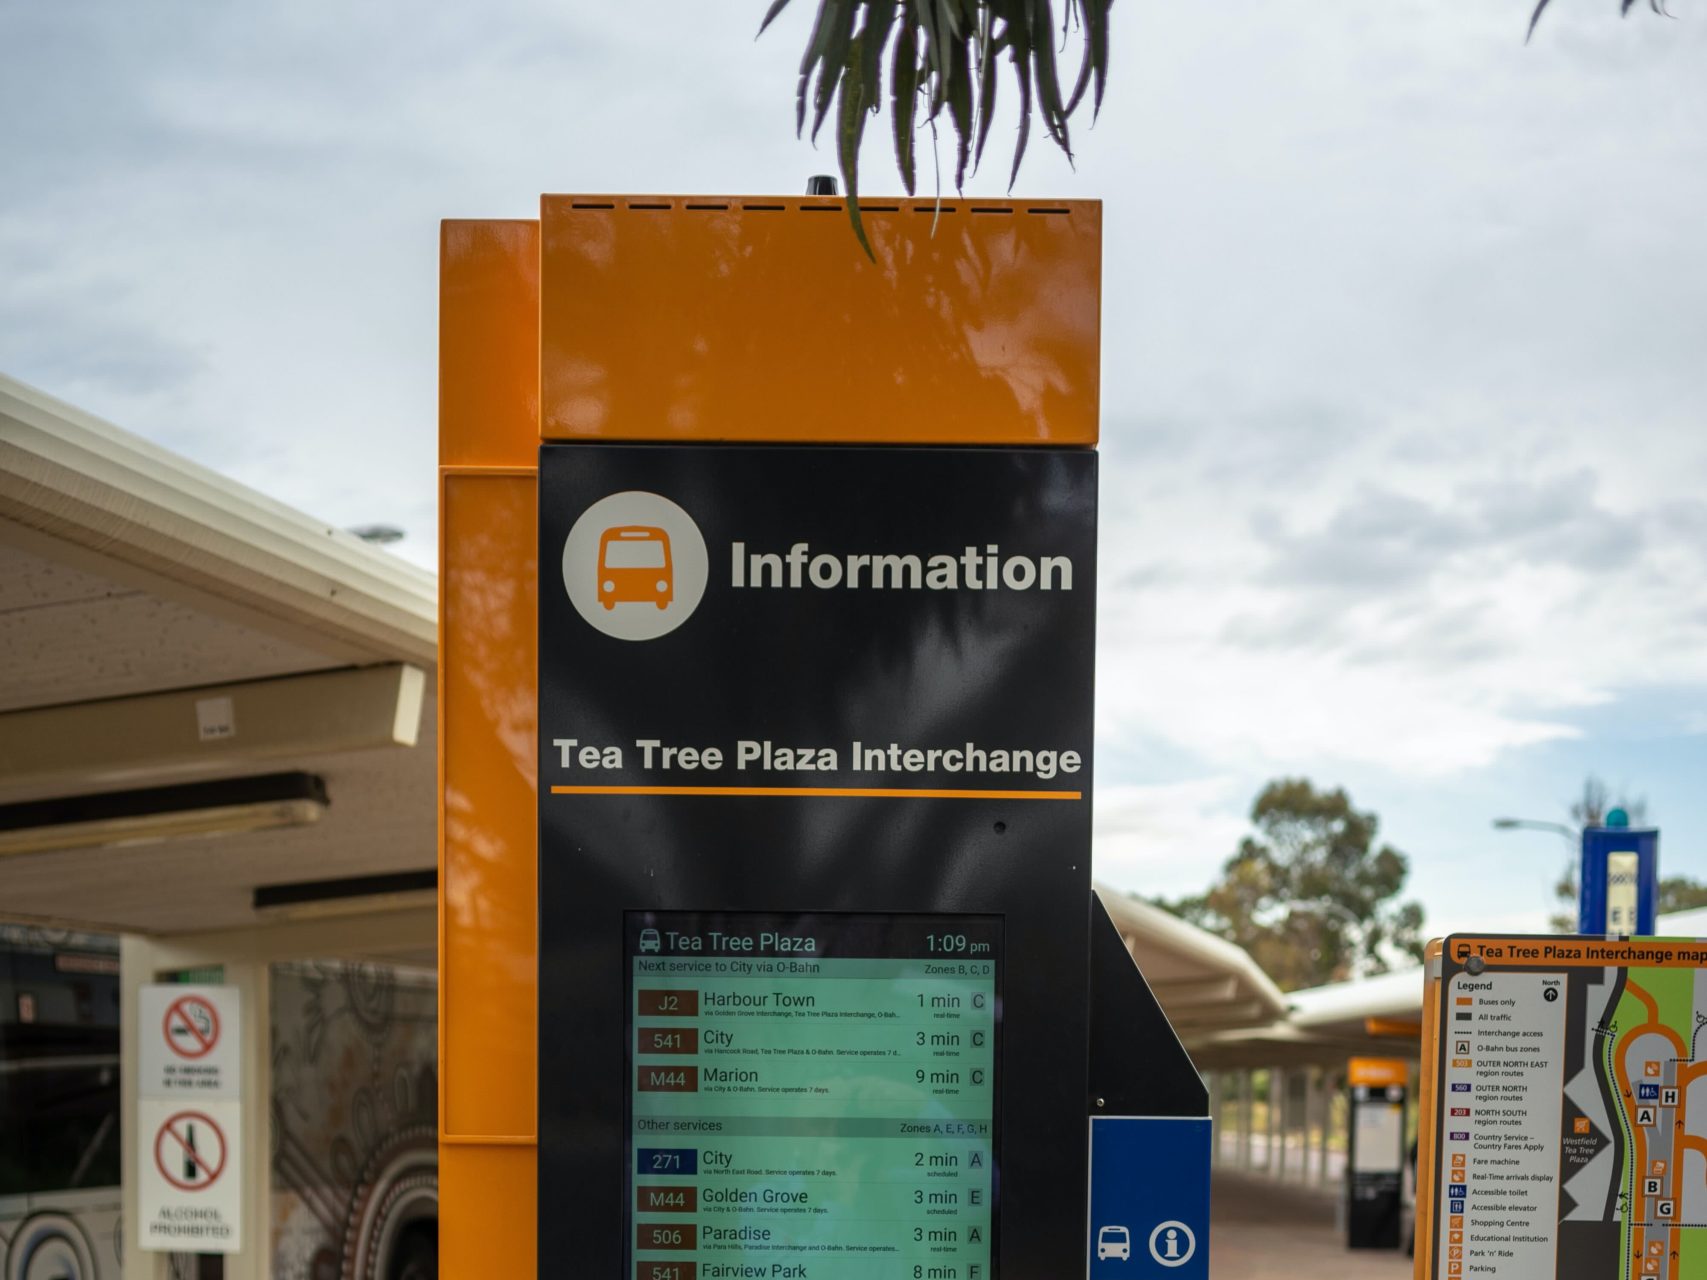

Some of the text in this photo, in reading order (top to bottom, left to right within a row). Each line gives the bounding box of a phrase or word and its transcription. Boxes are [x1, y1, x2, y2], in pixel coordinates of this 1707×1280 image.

[732, 542, 1072, 590] Information
[553, 739, 1081, 779] Tea Tree Plaza Interchange
[666, 932, 816, 953] Tea Tree Plaza
[926, 934, 991, 954] 1:09 pm
[1477, 945, 1707, 964] Tea Tree Plaza Interchange map
[639, 960, 820, 975] Next service to City via O-Bahn
[1458, 981, 1492, 992] Legend
[658, 996, 678, 1010] J2
[704, 992, 815, 1007] Harbour Town
[918, 994, 960, 1008] 1 min
[1500, 998, 1516, 1007] only
[654, 1034, 680, 1048] 541
[704, 1030, 733, 1047] City
[916, 1032, 959, 1046] 3 min
[1478, 1030, 1520, 1038] Interchange
[651, 1072, 685, 1086] M44
[704, 1068, 758, 1082] Marion
[916, 1069, 959, 1084] 9 min
[1476, 1070, 1499, 1078] region
[638, 1119, 722, 1131] Other services
[653, 1155, 679, 1168] 271
[703, 1151, 732, 1168] City
[915, 1152, 957, 1166] 2 min
[1531, 1174, 1553, 1183] display
[650, 1192, 685, 1206] M44
[703, 1188, 808, 1203] Golden Grove
[914, 1190, 957, 1204] 3 min
[1471, 1219, 1504, 1228] Shopping
[653, 1230, 681, 1244] 506
[703, 1226, 771, 1240] Paradise
[914, 1227, 957, 1241] 3 min
[1470, 1234, 1511, 1242] Educational
[653, 1267, 678, 1280] 541
[703, 1264, 806, 1278] Fairview Park
[913, 1265, 956, 1279] 8 min
[1469, 1265, 1496, 1274] Parking
